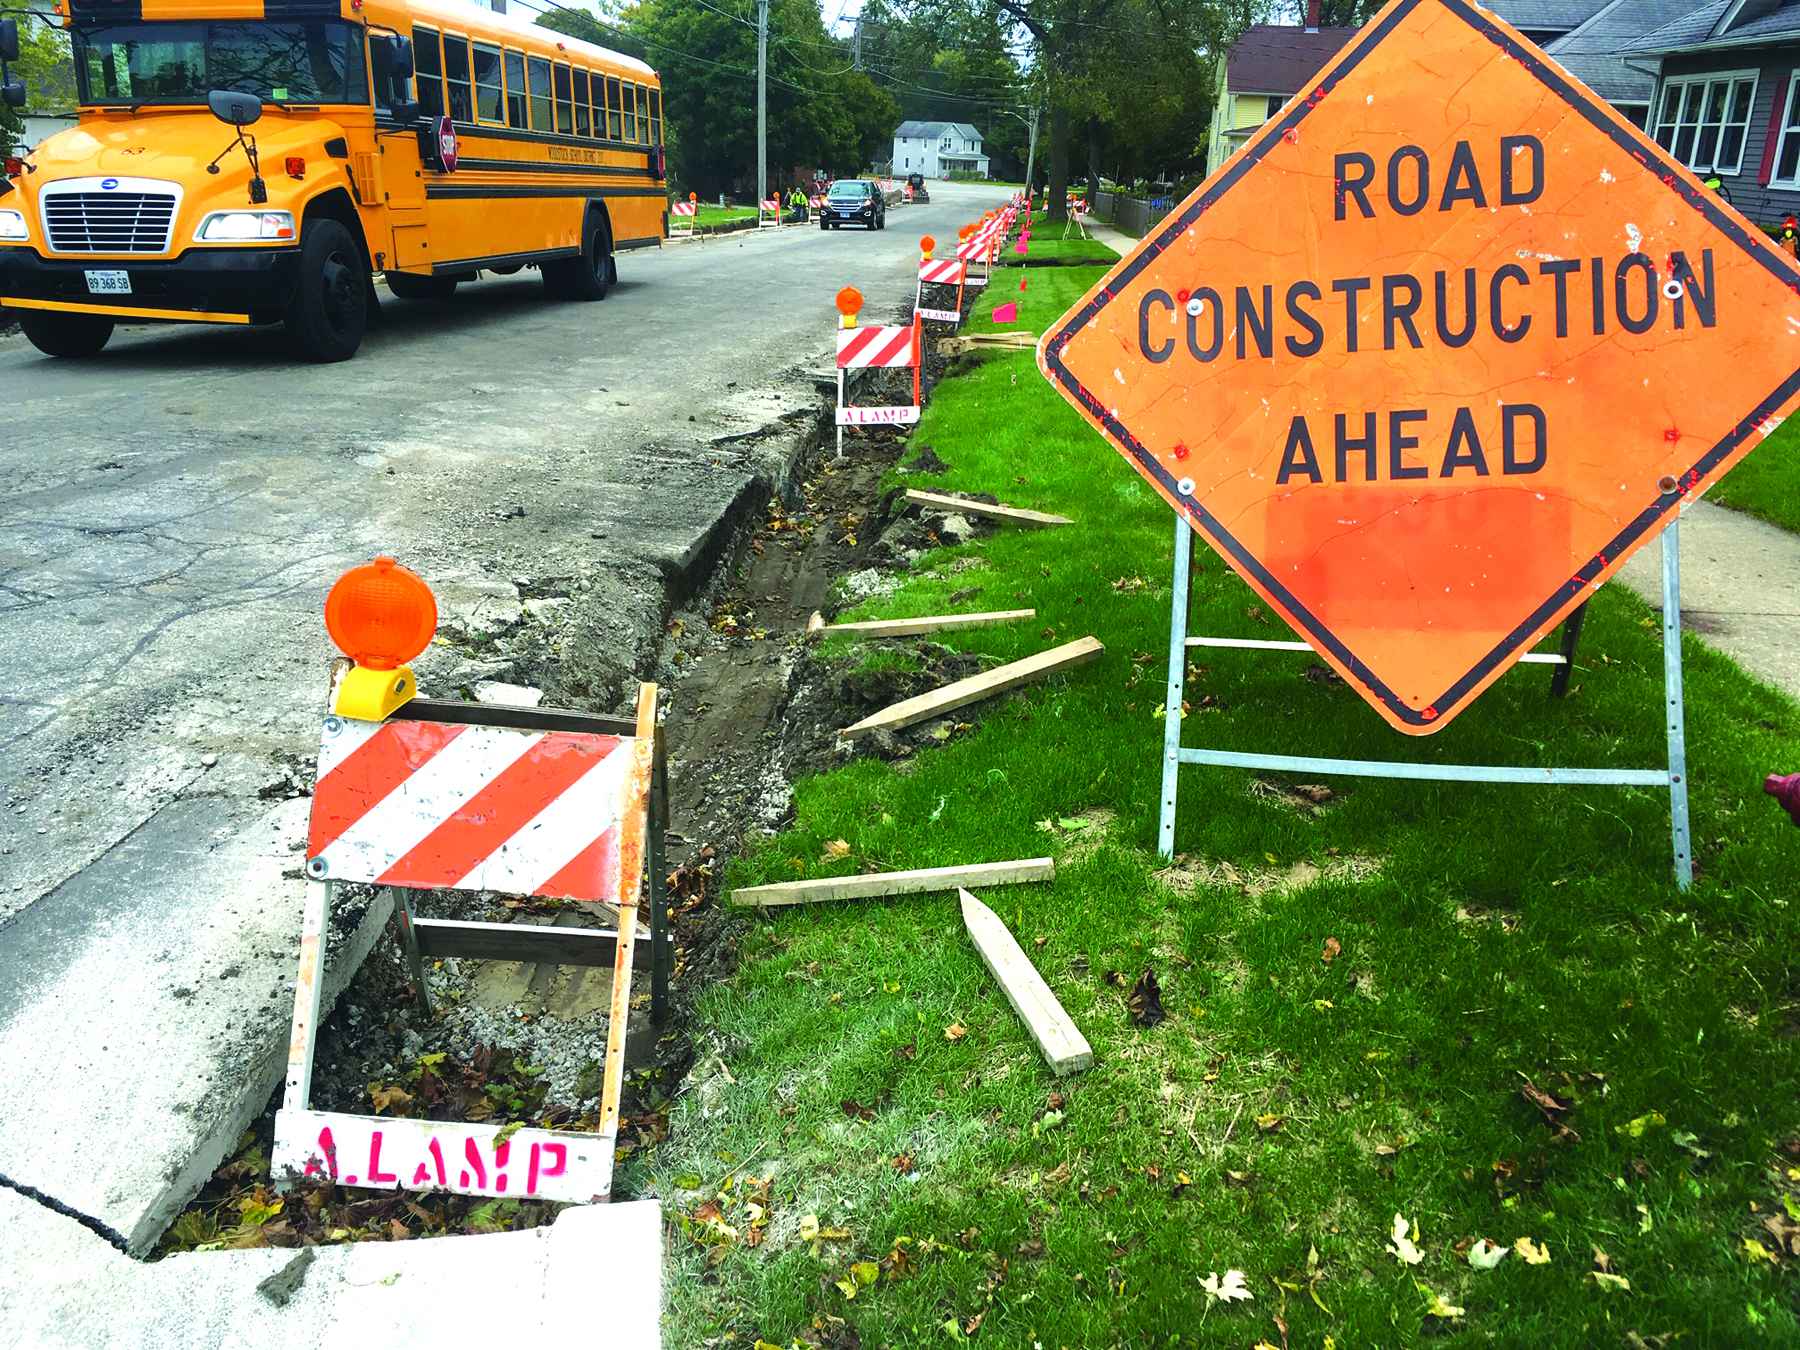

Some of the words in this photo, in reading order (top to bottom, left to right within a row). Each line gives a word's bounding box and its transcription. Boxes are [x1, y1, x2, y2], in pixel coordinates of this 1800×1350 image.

[1334, 134, 1545, 222] ROAD
[88, 277, 99, 289] 89
[100, 277, 116, 289] 368
[117, 277, 129, 289] SB
[1138, 248, 1718, 364] CONSTRUCTION
[1275, 403, 1548, 485] AHEAD
